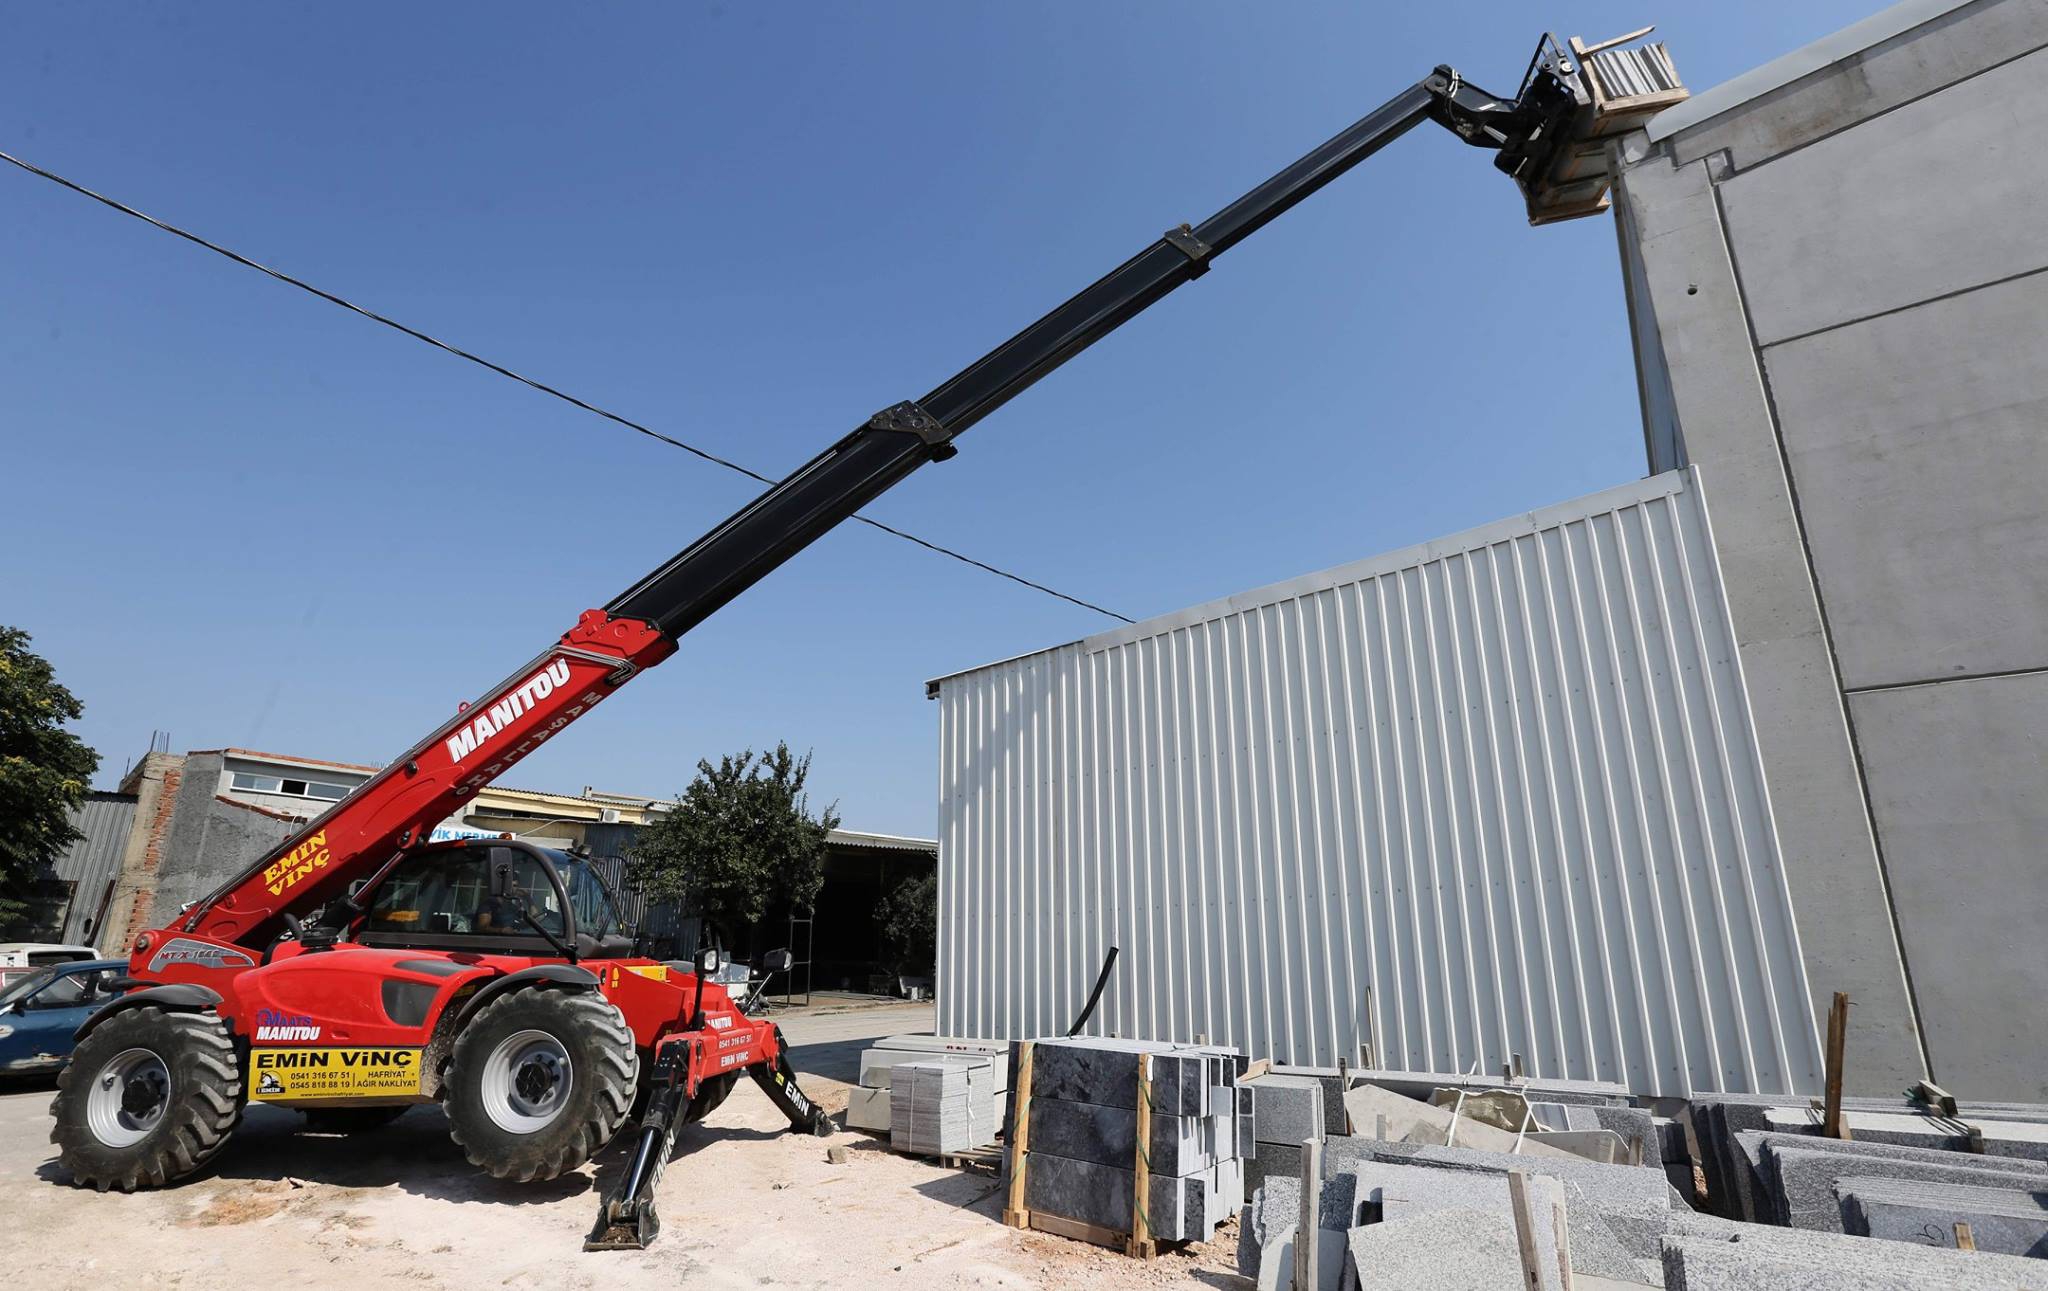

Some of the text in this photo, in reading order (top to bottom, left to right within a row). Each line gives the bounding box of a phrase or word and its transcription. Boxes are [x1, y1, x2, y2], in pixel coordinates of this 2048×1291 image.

[445, 658, 571, 764] MANITOU
[256, 1026, 321, 1041] MANITOU
[290, 1072, 310, 1080] 0541
[312, 1072, 326, 1080] 316
[341, 1071, 350, 1079] 51
[368, 1070, 406, 1079] HAFRİYAT
[328, 1081, 338, 1089] 88
[341, 1081, 350, 1089] 19
[356, 1079, 417, 1088] AĞIR NAKLİYAT
